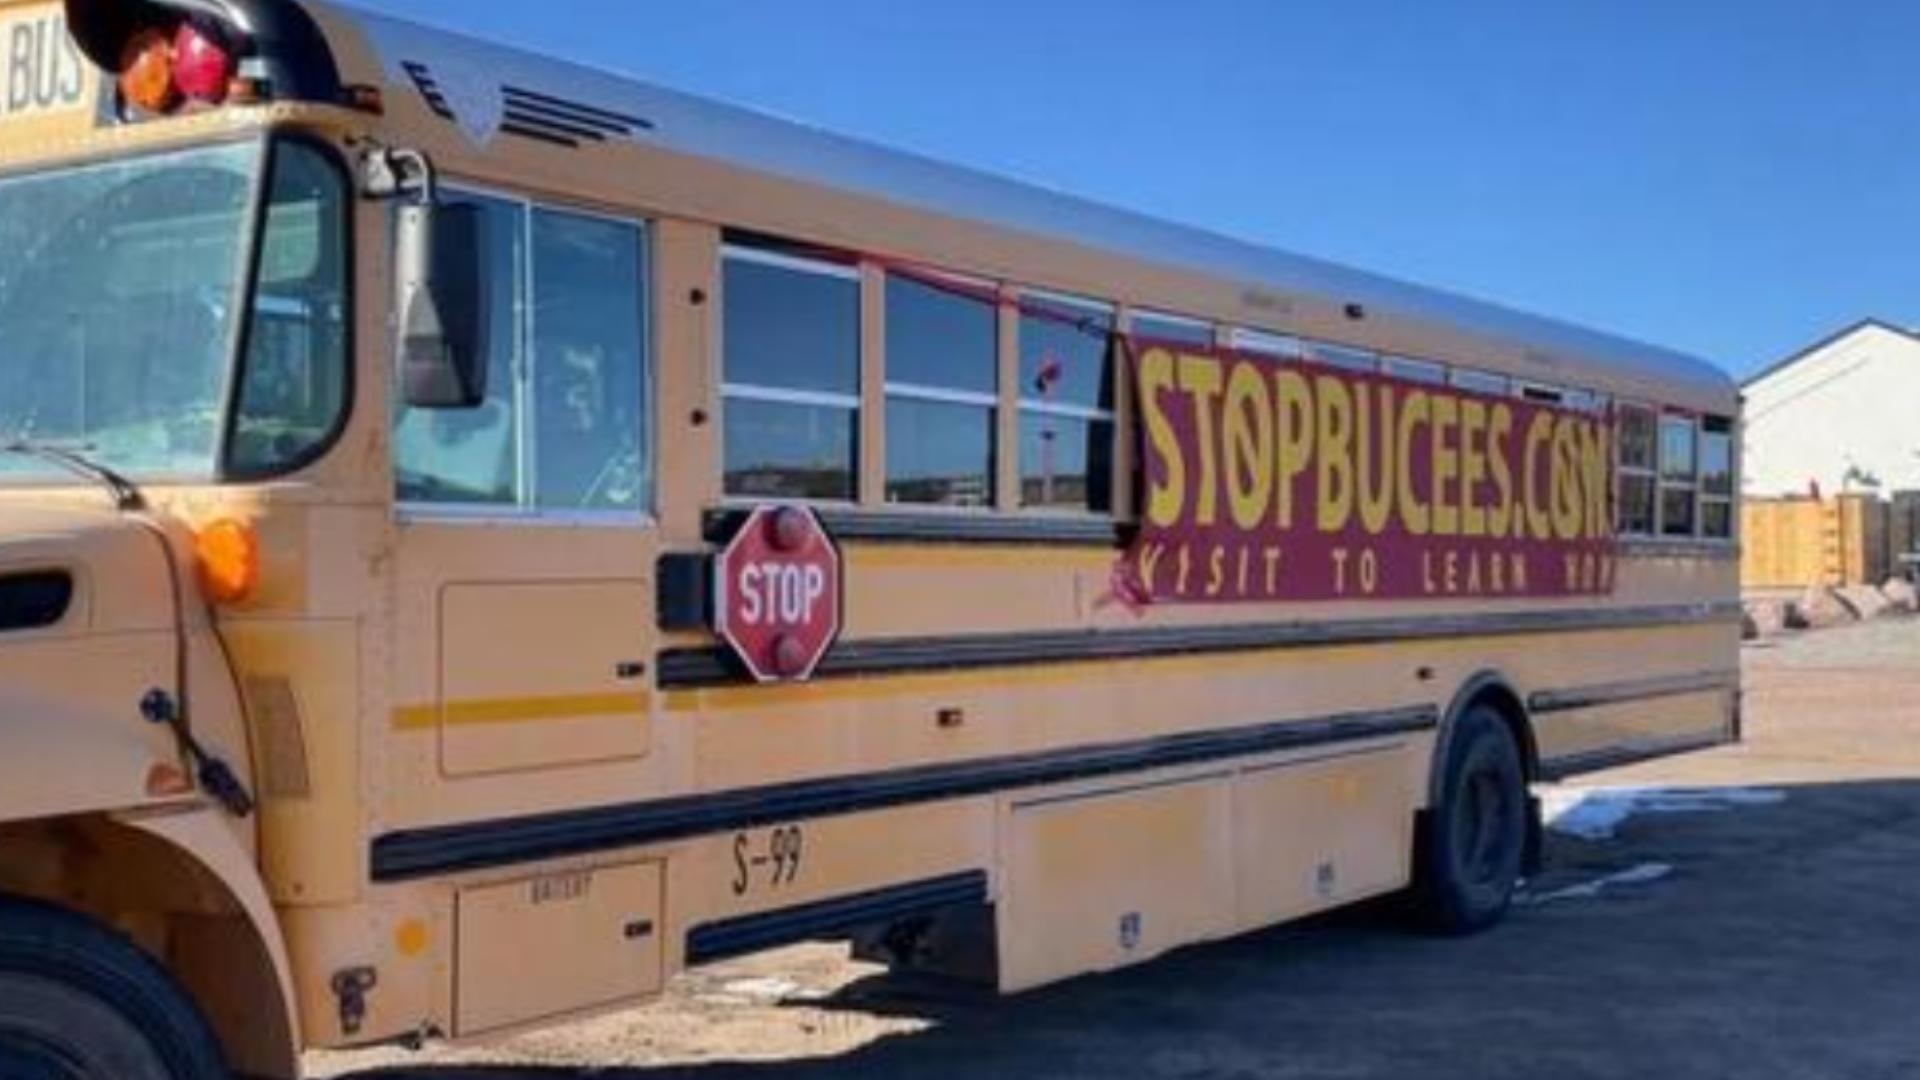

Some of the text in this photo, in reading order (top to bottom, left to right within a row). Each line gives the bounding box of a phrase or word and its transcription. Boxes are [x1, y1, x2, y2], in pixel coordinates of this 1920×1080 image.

[9, 14, 84, 112] BUS
[1139, 347, 1613, 539] STOPBUCEES.COM
[739, 562, 824, 625] STOP
[1139, 543, 1282, 595] VISIT
[1332, 546, 1377, 594] TO
[1423, 548, 1527, 594] LEARN
[732, 825, 803, 897] S-99
